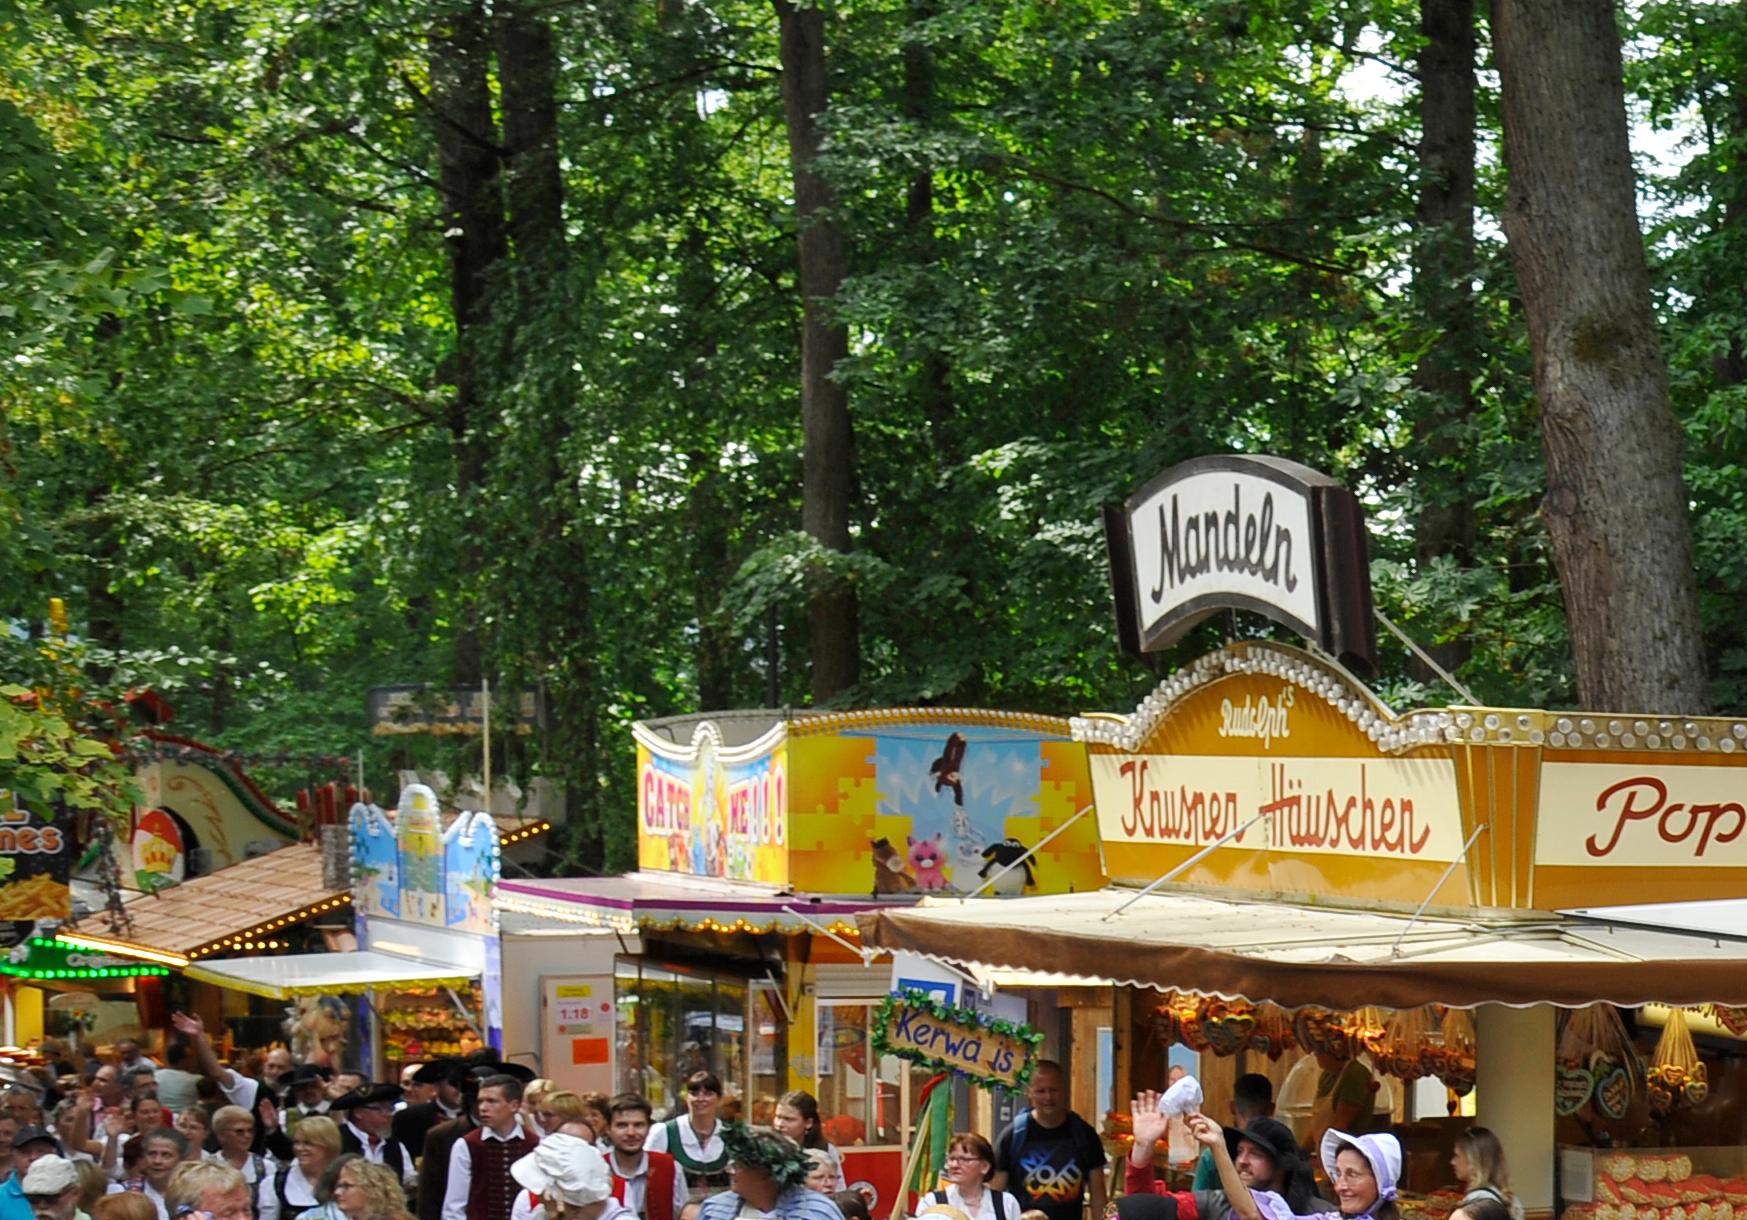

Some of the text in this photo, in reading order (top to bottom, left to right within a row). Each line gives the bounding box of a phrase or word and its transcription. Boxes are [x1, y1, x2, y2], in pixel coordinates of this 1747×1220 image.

[1151, 483, 1298, 604] Mandeln
[1120, 760, 1431, 854] Knusper Häuschen
[896, 1007, 1015, 1073] Kerwa is
